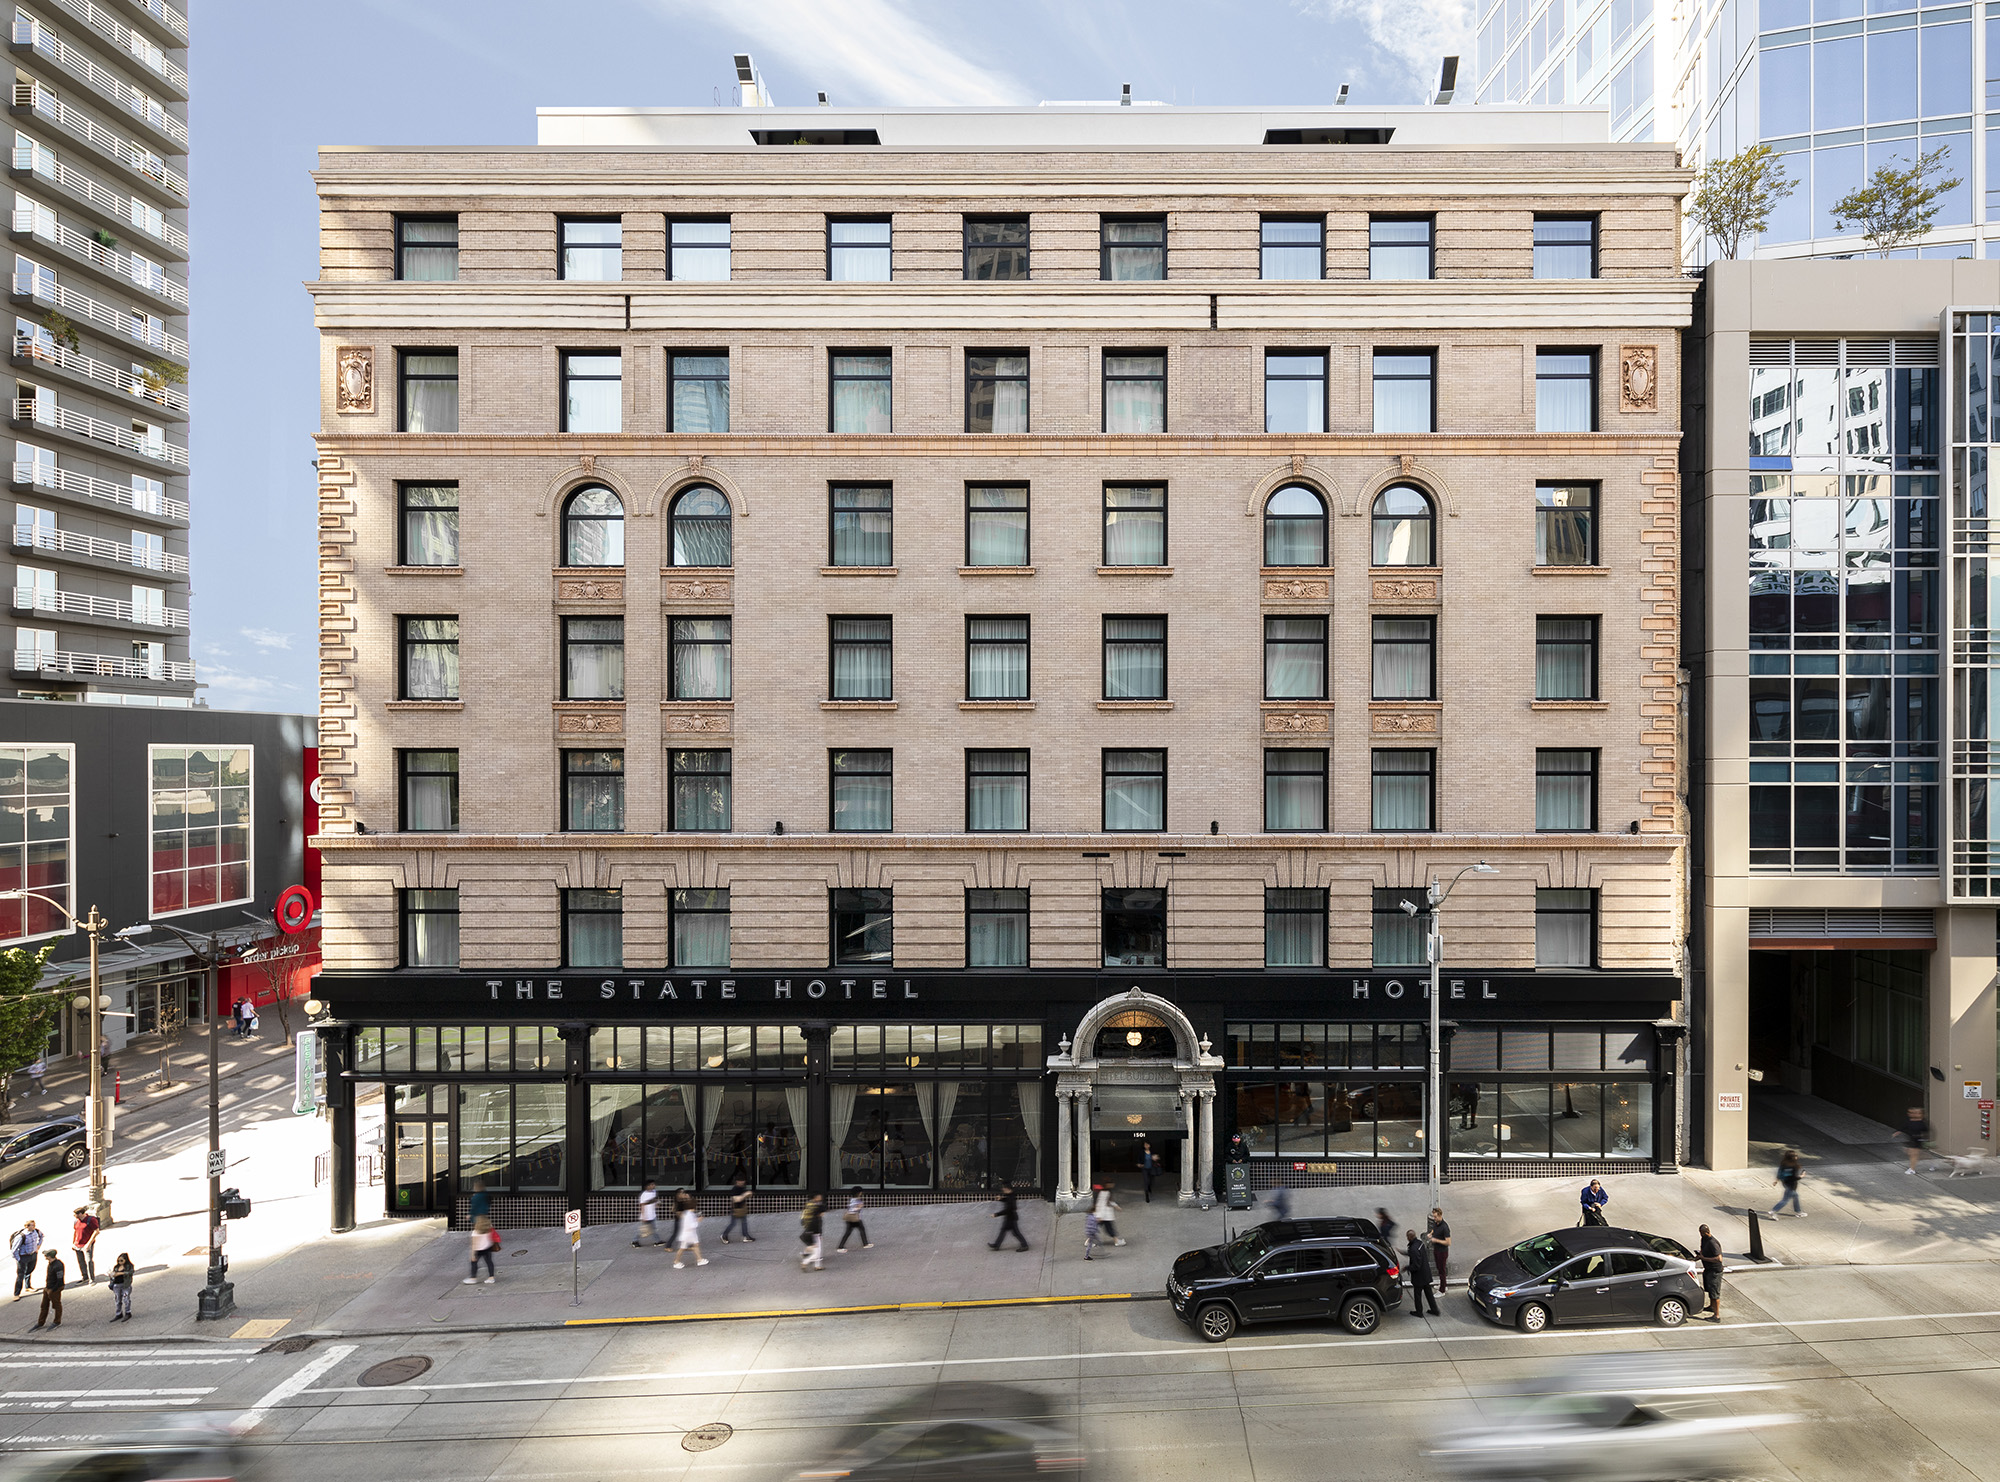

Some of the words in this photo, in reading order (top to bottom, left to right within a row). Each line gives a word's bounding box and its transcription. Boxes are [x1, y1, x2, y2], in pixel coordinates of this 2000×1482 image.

[243, 951, 269, 965] order
[270, 944, 300, 960] pickup
[486, 980, 563, 999] THE
[600, 980, 737, 999] STATE
[774, 979, 919, 999] HOTEL
[1352, 979, 1498, 999] HOTEL
[1720, 1095, 1741, 1103] PRIVATE
[209, 1150, 224, 1160] ONE
[209, 1158, 225, 1168] WAY
